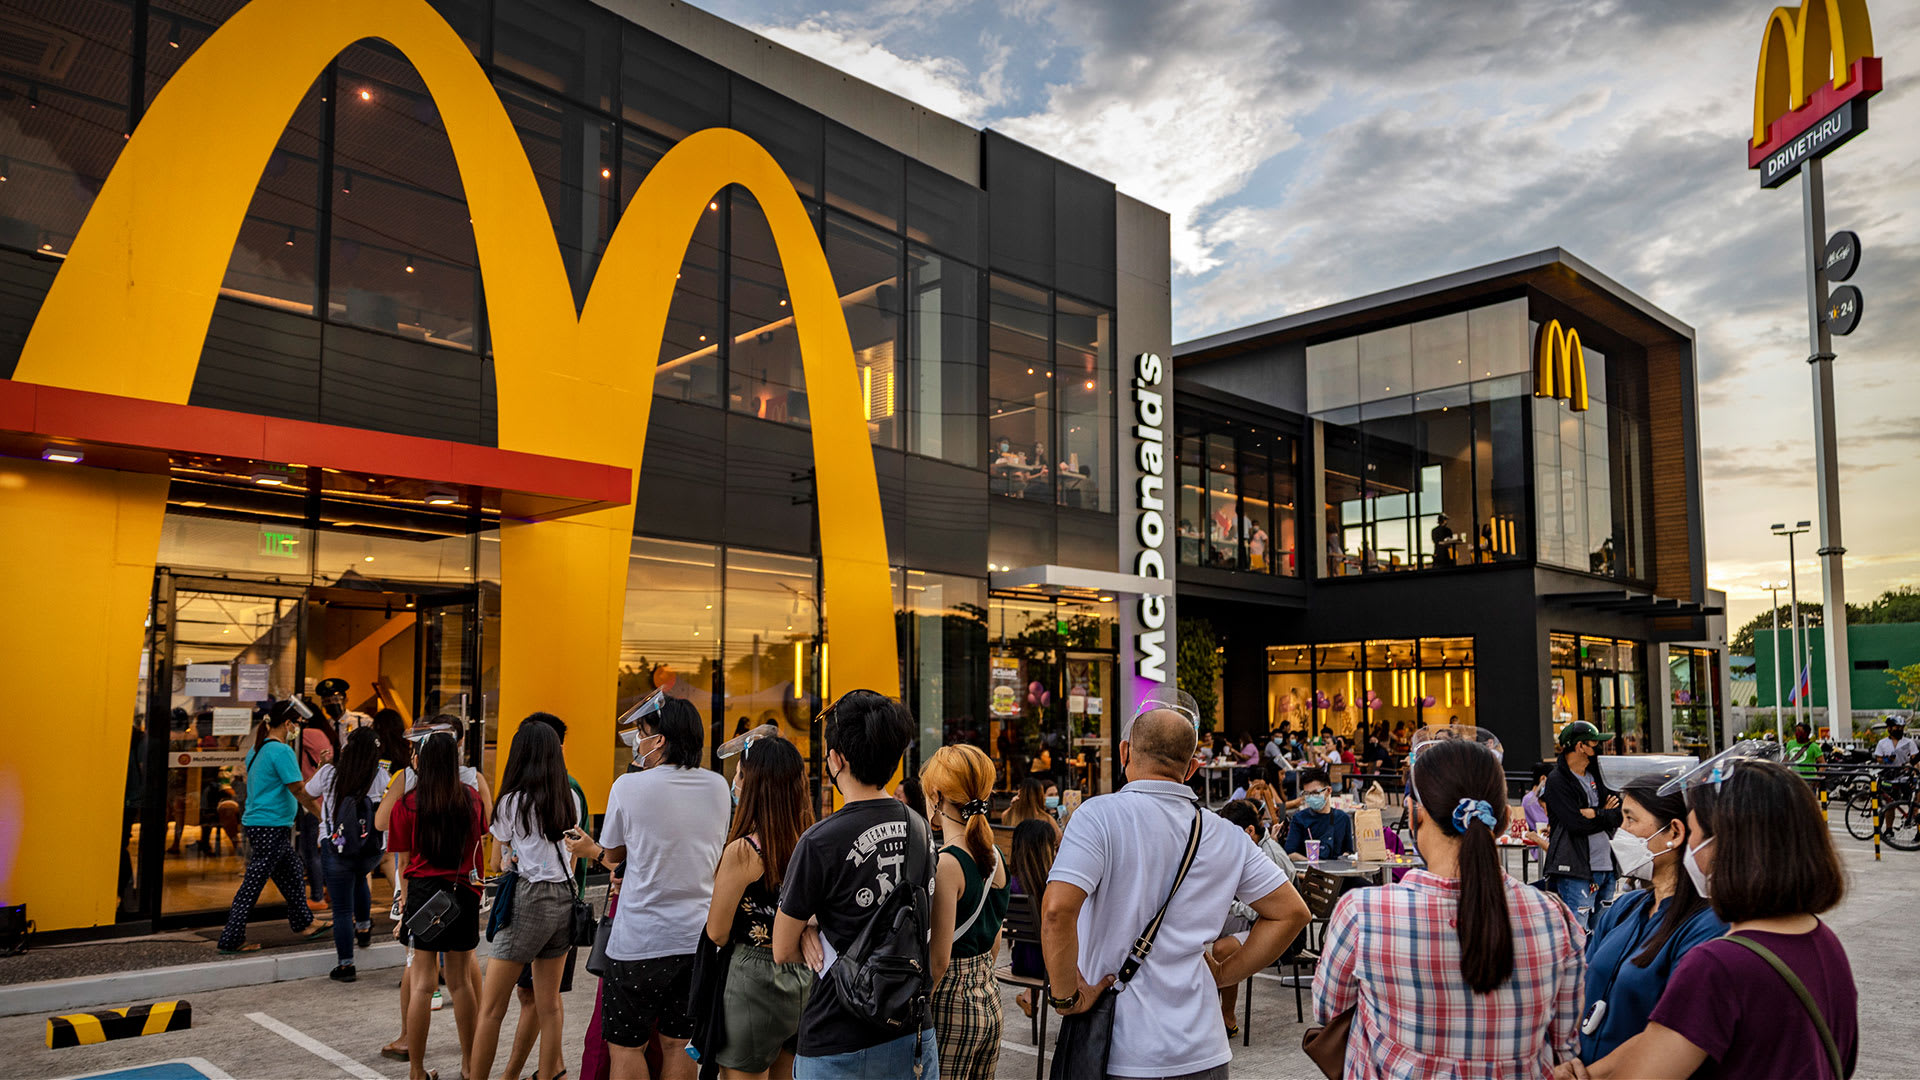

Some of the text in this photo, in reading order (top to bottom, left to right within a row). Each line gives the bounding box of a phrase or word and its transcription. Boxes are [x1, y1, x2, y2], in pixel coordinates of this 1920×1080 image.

[1768, 113, 1841, 176] DRIVETHRU
[1841, 300, 1853, 317] 24
[865, 824, 907, 843] TEAM MAN
[884, 841, 907, 852] LOCA
